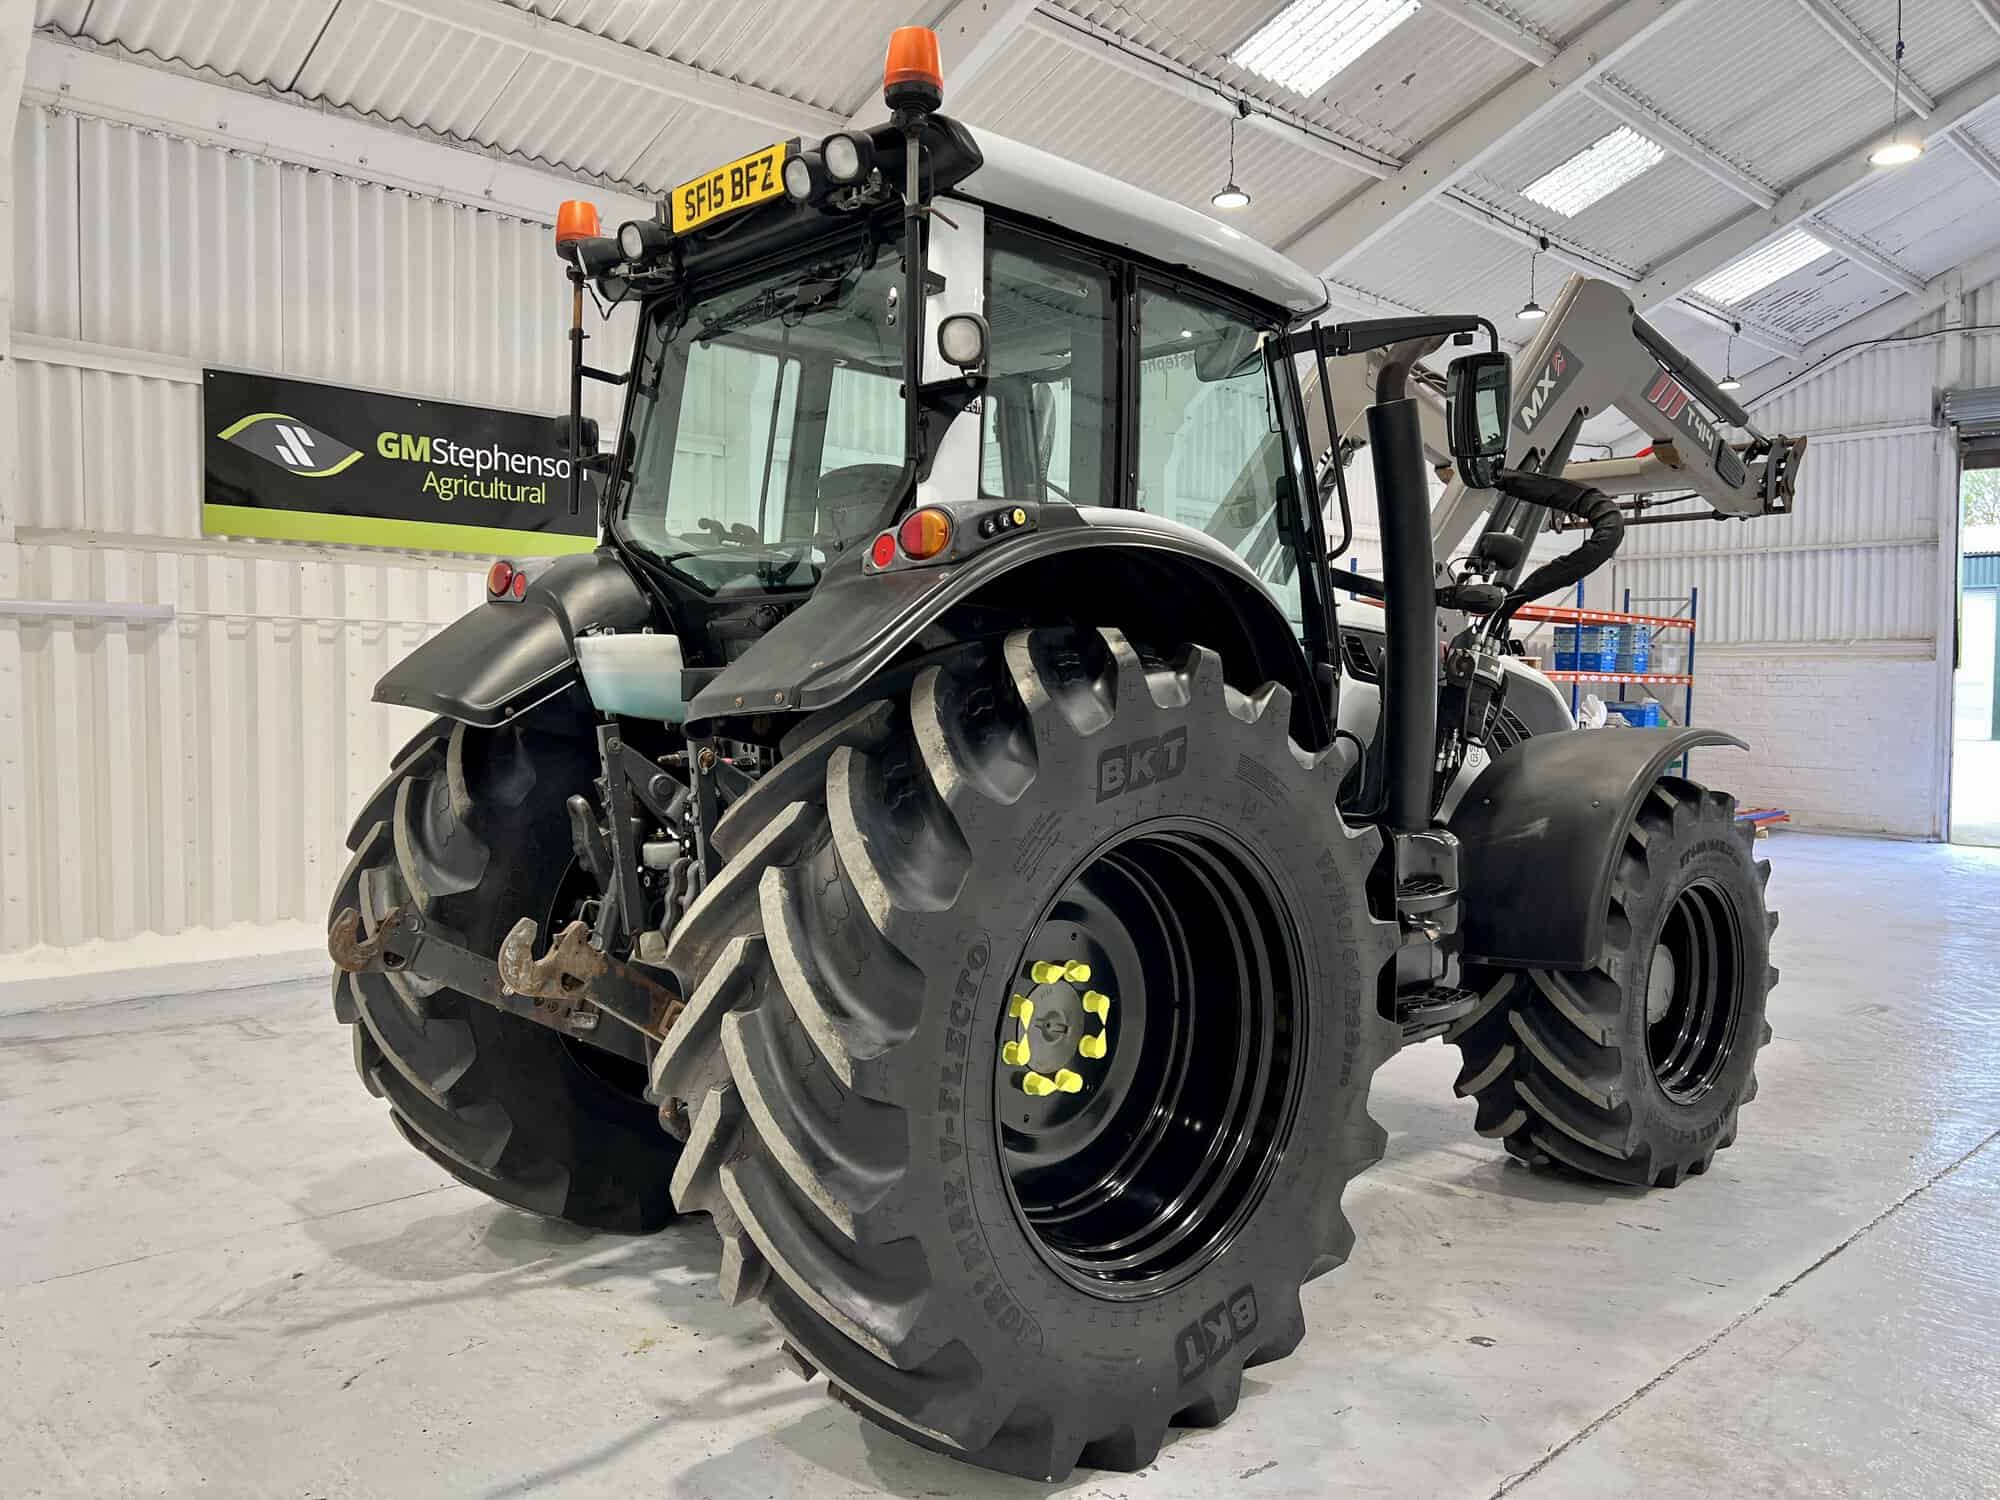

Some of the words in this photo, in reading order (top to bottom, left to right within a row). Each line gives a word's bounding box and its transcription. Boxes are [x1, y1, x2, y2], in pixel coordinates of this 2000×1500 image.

[685, 173, 724, 222] SF15
[730, 154, 774, 202] BFZ
[1520, 363, 1557, 430] MX
[422, 470, 546, 505] Agricultural
[1100, 736, 1186, 798] BKT
[1179, 1288, 1257, 1380] BKT
